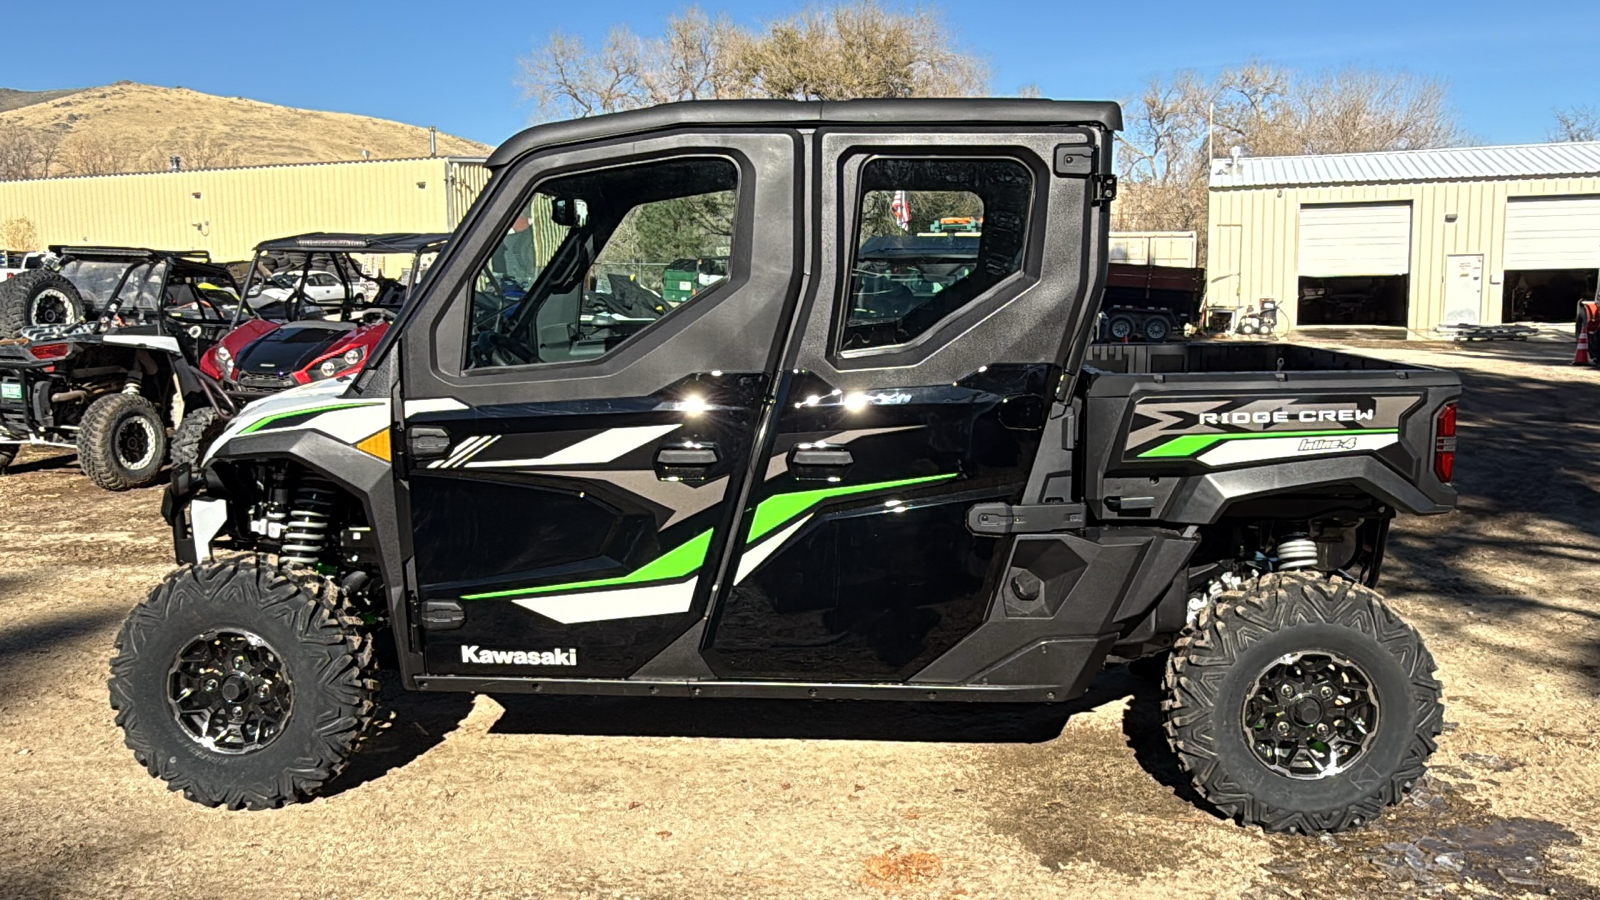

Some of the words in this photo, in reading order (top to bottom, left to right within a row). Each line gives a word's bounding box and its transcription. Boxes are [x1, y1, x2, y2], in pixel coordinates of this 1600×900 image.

[1199, 411, 1289, 425] RIDGE
[1298, 409, 1374, 422] CREW
[461, 645, 577, 666] Kawasaki
